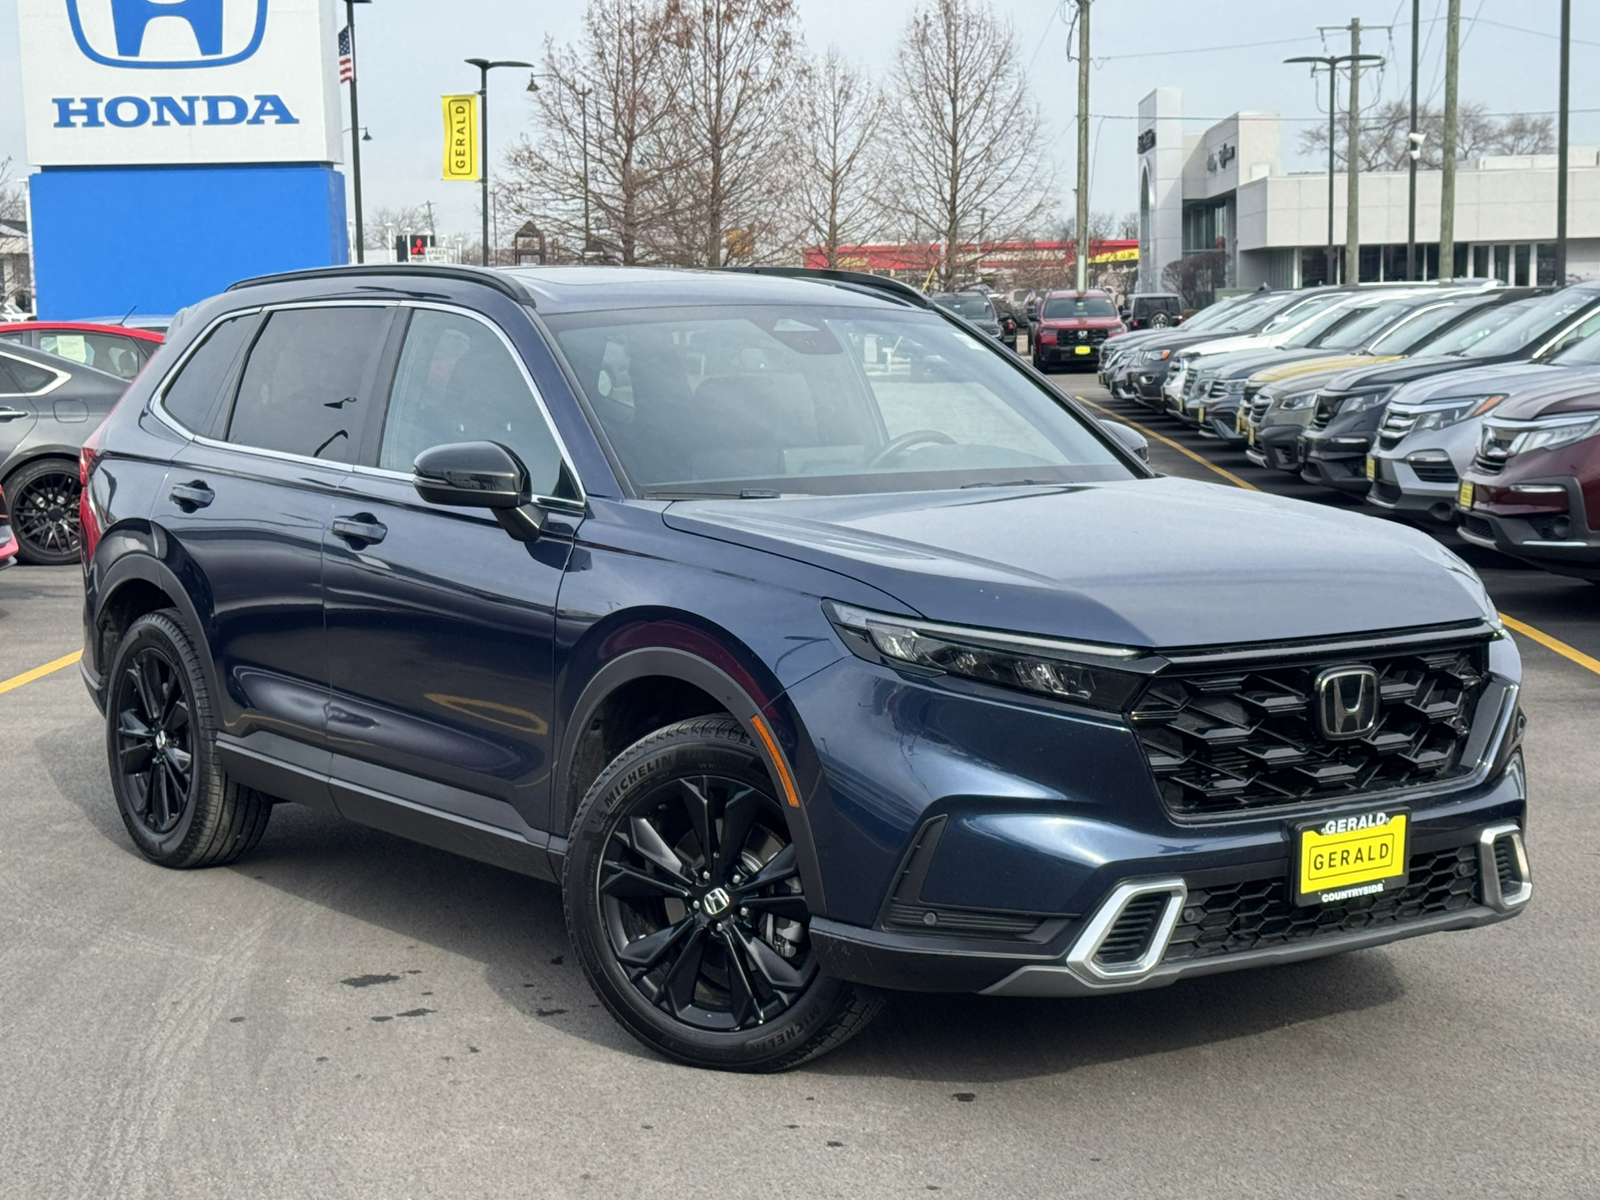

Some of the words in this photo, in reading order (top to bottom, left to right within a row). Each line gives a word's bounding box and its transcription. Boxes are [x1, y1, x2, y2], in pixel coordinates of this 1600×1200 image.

[51, 94, 300, 128] HONDA
[455, 104, 467, 170] GERALD
[604, 754, 672, 809] MICHELIN
[1324, 812, 1387, 835] GERALD
[1313, 843, 1390, 871] GERALD
[1321, 883, 1385, 903] COUNTRYSIDE
